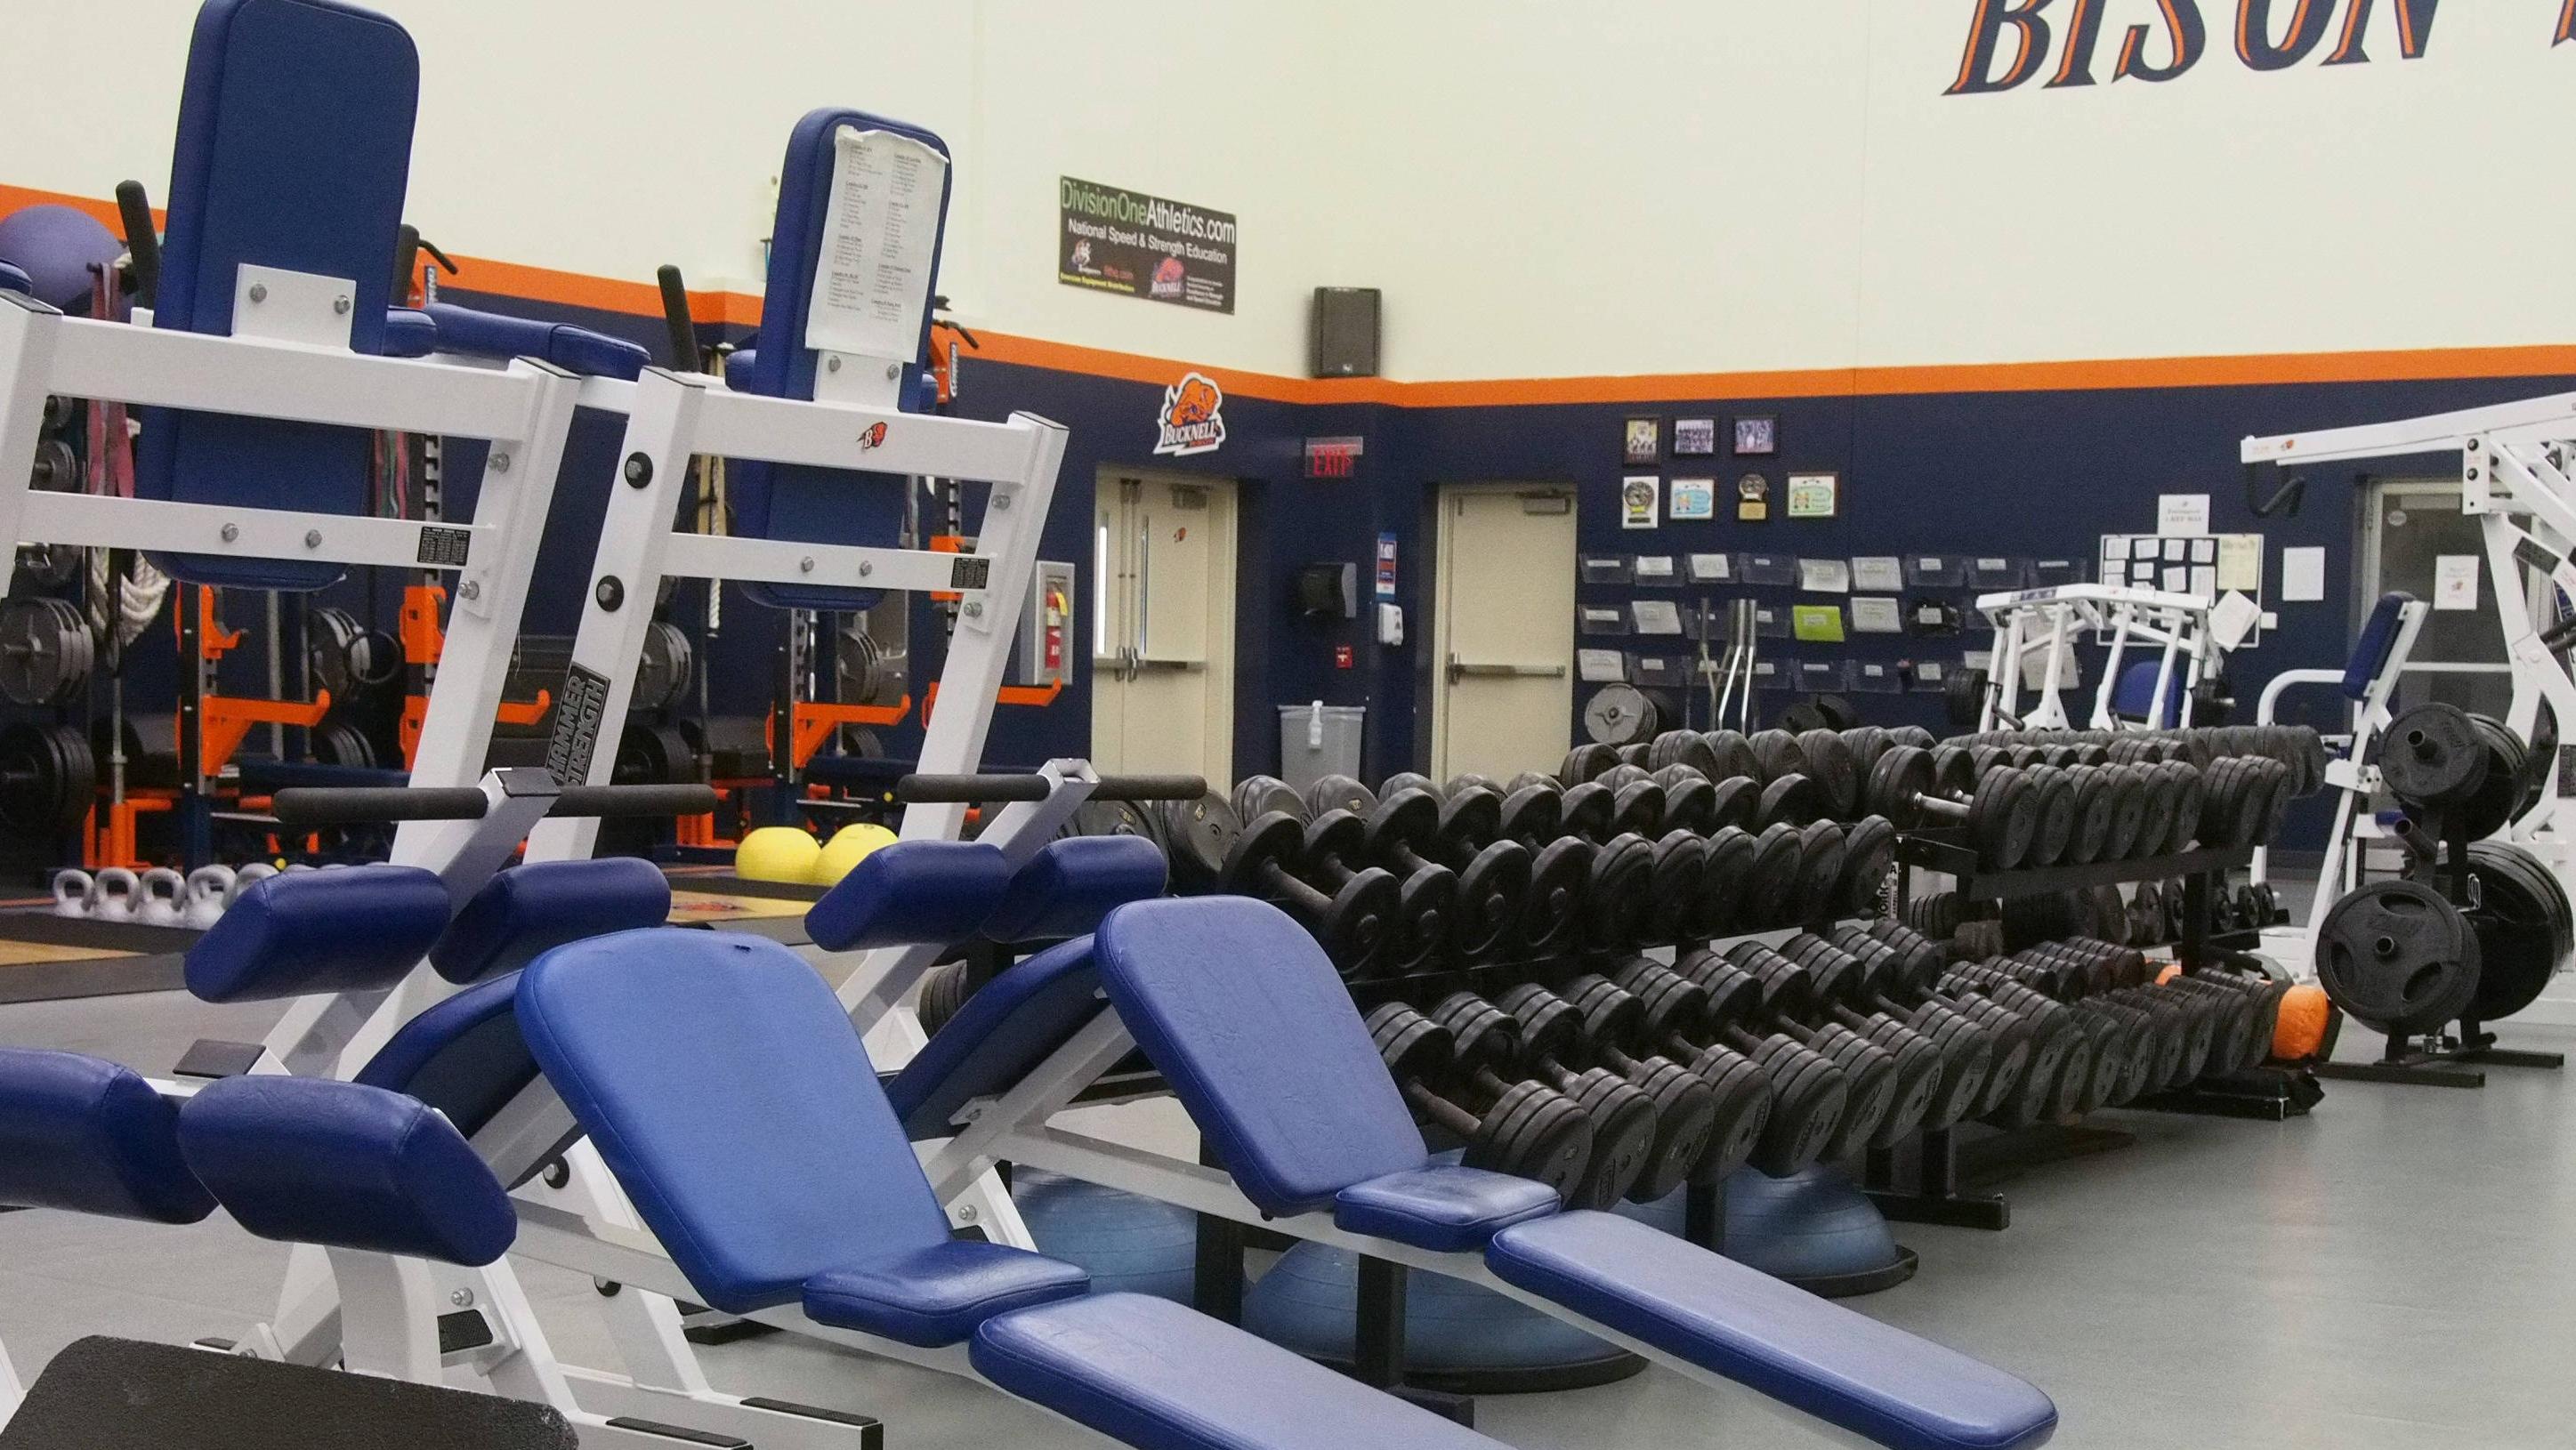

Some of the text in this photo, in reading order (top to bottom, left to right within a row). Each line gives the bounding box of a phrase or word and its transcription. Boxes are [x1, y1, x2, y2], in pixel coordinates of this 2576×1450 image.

[1062, 180, 1235, 245] DivisionOneAthletics.com
[1068, 217, 1228, 264] National Speed & Strength Education
[1165, 422, 1216, 445] BUCKNELL
[1313, 447, 1353, 477] EXIT
[549, 675, 585, 782] HAMMER
